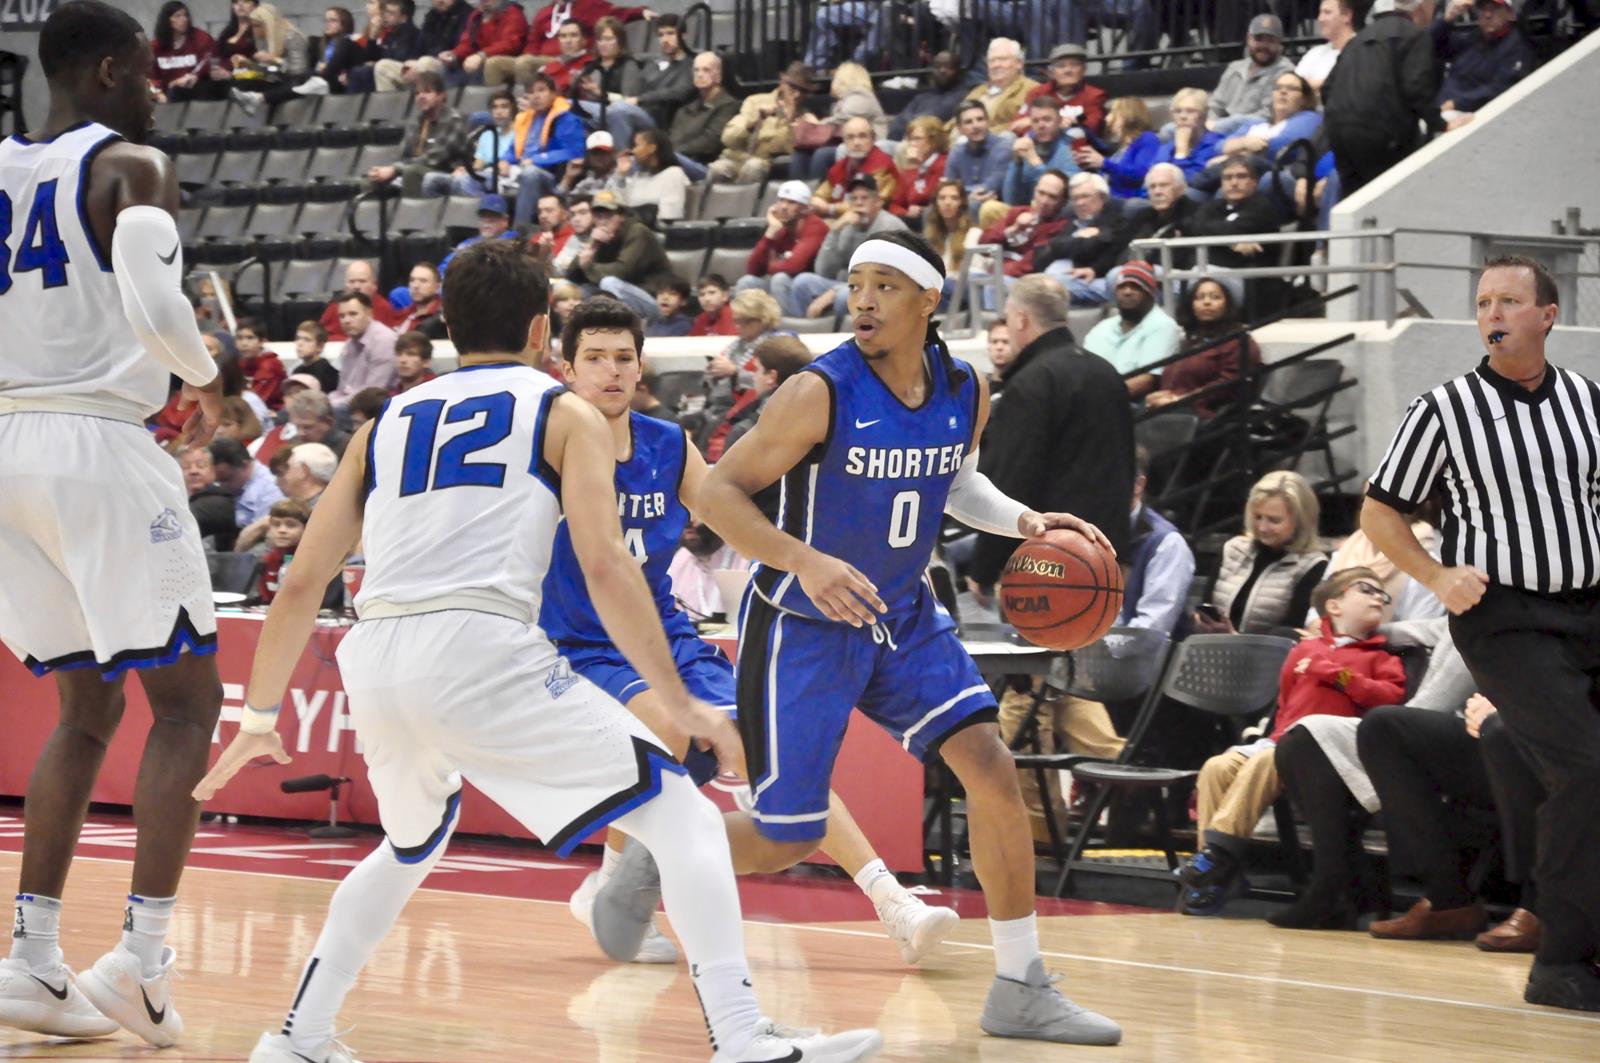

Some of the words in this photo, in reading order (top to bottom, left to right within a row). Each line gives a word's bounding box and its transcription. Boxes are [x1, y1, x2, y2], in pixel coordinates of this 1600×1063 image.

[398, 390, 517, 498] 12
[845, 443, 965, 479] SHORTER
[887, 490, 921, 549] 0
